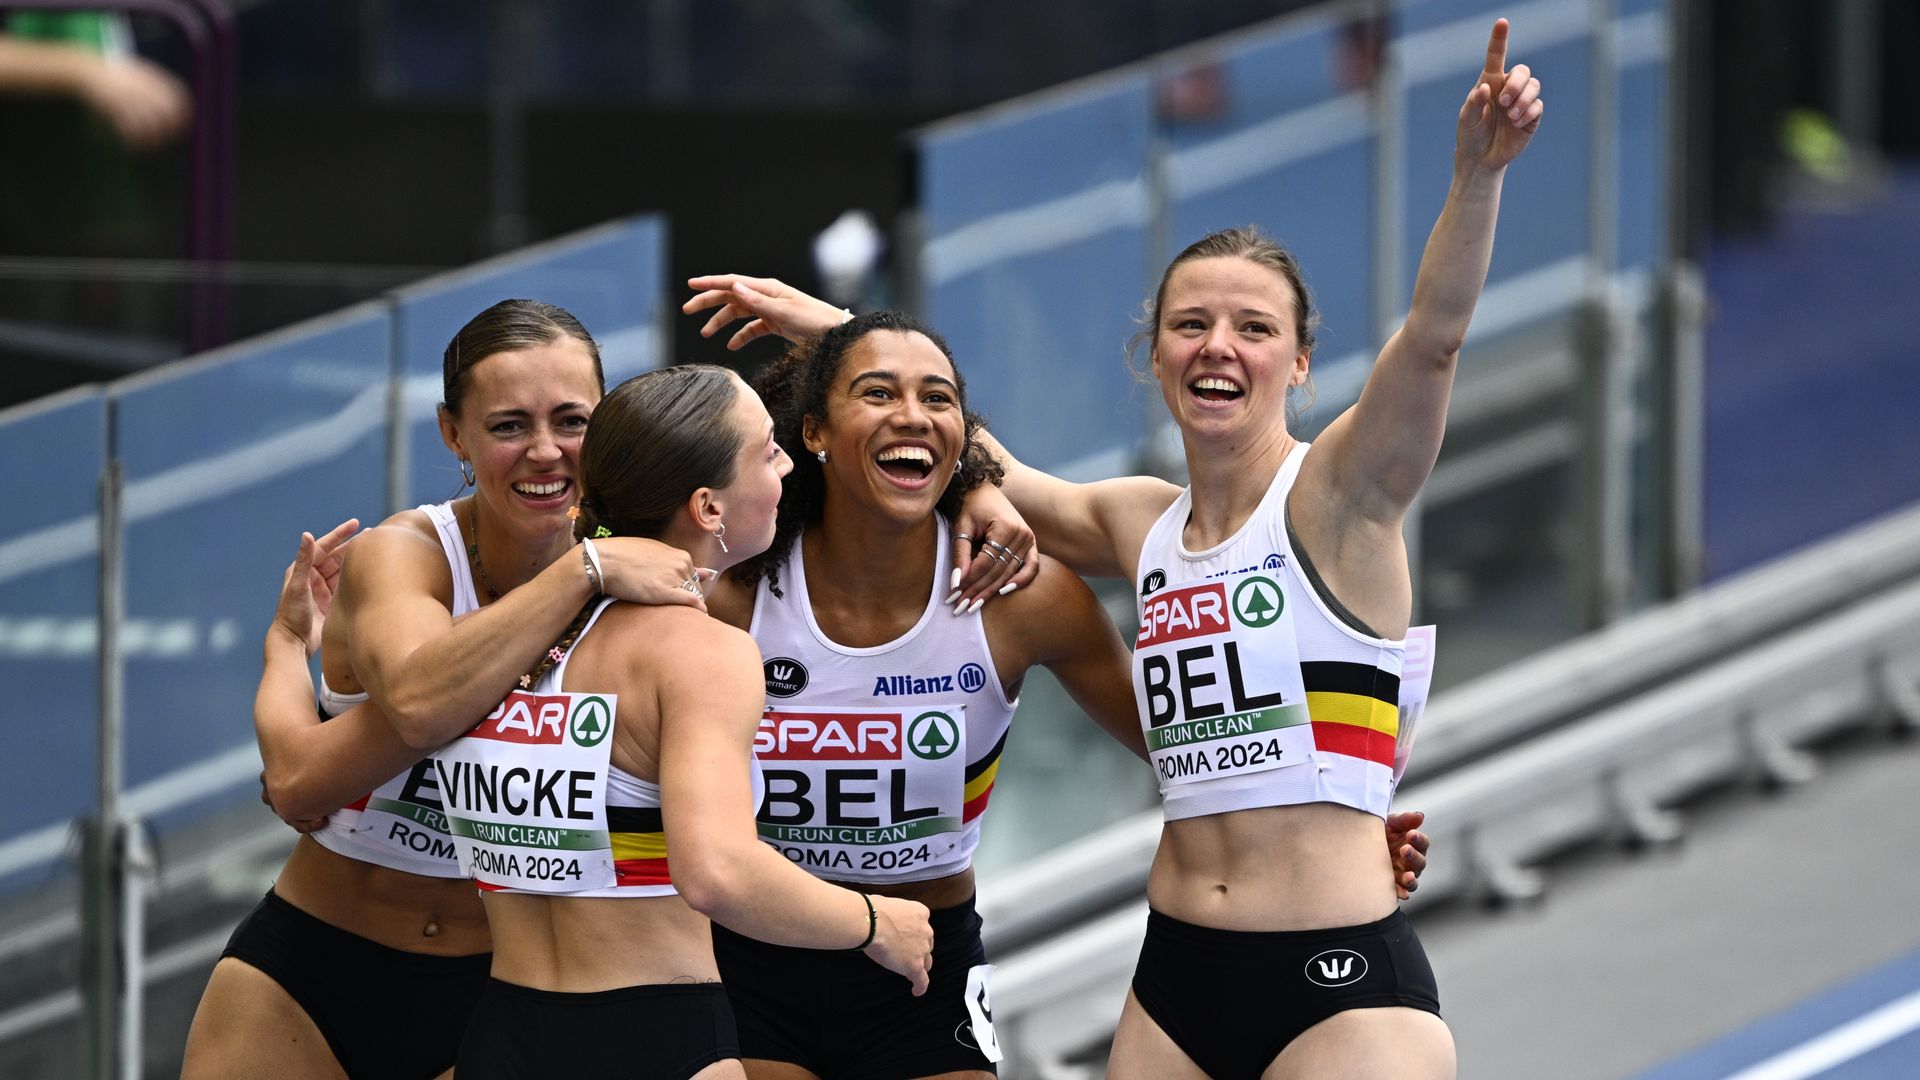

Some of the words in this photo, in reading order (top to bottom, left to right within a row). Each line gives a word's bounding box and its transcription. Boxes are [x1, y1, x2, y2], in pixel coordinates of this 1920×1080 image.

[1138, 591, 1225, 642] SPAR
[765, 679, 798, 691] ermarc
[872, 675, 954, 697] Allianz
[1143, 641, 1283, 729] BEL
[475, 700, 565, 738] AR
[752, 719, 898, 754] SPAR
[1164, 719, 1193, 744] RUN
[1158, 750, 1212, 780] ROMA
[1216, 738, 1283, 771] 2024
[436, 759, 596, 821] VINCKE
[756, 768, 939, 827] BEL
[423, 811, 451, 831] RU
[477, 823, 506, 842] RUN
[777, 827, 782, 839] I
[788, 827, 834, 842] RUN
[388, 821, 459, 860] ROM
[763, 841, 854, 869] OMA
[860, 844, 931, 870] 2024
[472, 846, 522, 878] ROMA
[525, 855, 583, 881] 2024
